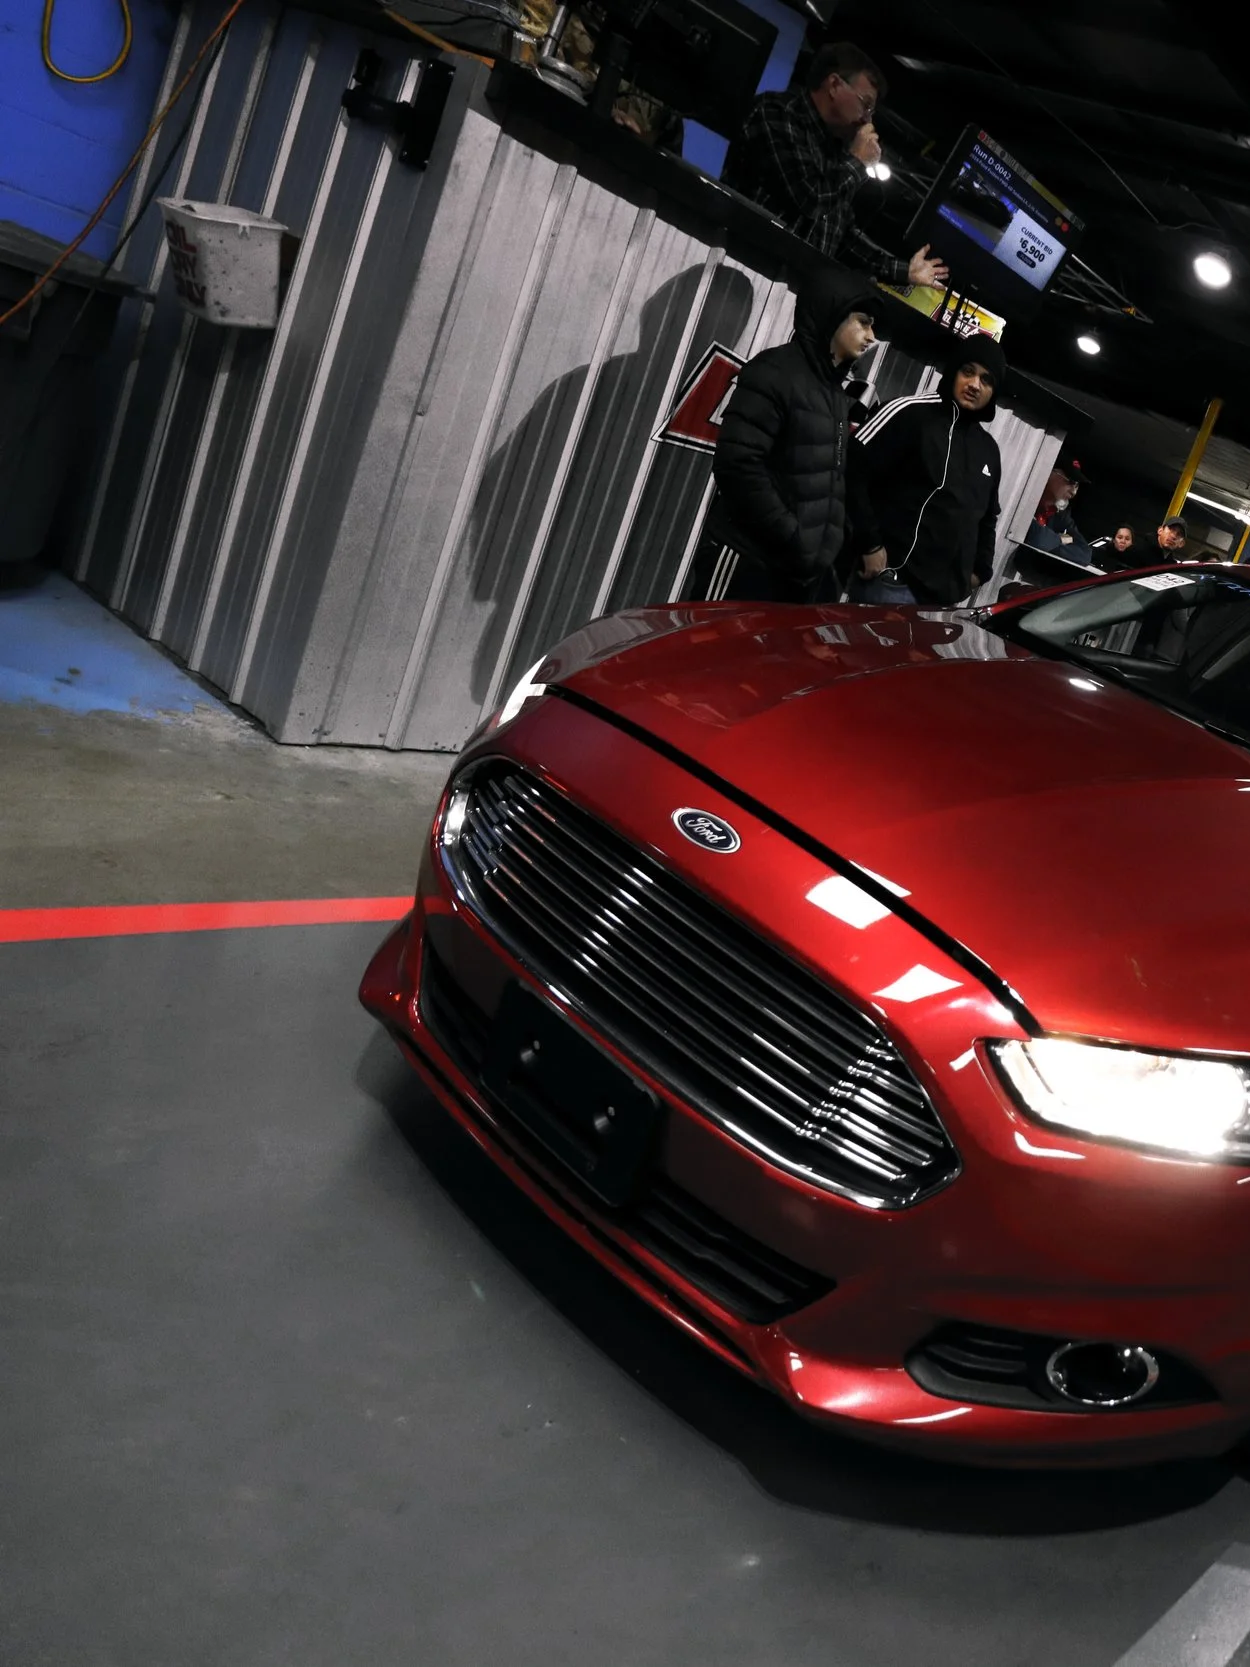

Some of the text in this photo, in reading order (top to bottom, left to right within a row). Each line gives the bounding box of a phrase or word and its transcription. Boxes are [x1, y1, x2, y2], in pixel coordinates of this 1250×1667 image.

[973, 144, 988, 161] Run
[987, 154, 1012, 181] D-0042
[165, 220, 198, 254] OIL
[1019, 237, 1046, 263] $6,900
[1021, 226, 1054, 256] CURRENT BID
[685, 817, 727, 844] Ford
